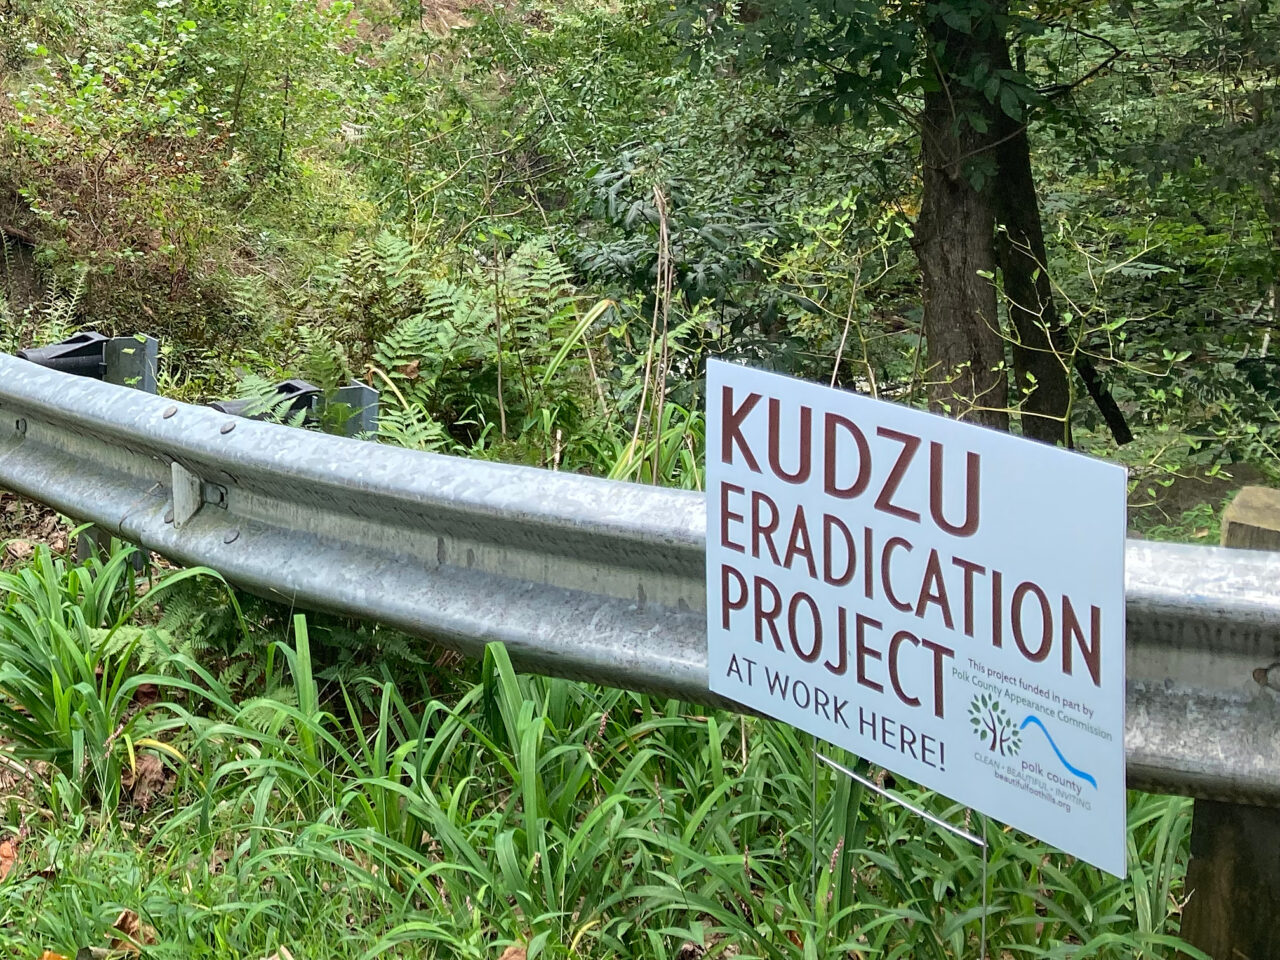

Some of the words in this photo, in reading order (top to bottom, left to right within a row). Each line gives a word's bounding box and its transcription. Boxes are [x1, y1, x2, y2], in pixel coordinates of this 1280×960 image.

[721, 385, 981, 538] KUDZU
[720, 481, 1101, 688] ERADICATION
[721, 564, 955, 719] PROJECT
[726, 653, 757, 689] AT
[764, 670, 850, 729] WORK
[859, 707, 946, 772] HERE!
[952, 667, 970, 683] Polk
[971, 675, 1002, 696] County
[1004, 689, 1056, 718] Appearance
[1057, 710, 1113, 742] Commission
[968, 658, 986, 674] This
[987, 666, 1017, 686] project
[1019, 678, 1050, 699] funded
[1052, 690, 1061, 704] in
[1063, 698, 1080, 715] part
[1082, 704, 1094, 719] by
[974, 751, 1001, 770] CLEAN
[1006, 765, 1049, 791] BEAUTIFUL
[1055, 784, 1092, 811] INVITING
[994, 770, 1071, 813] beautifulfoothills.org
[1021, 760, 1043, 777] polk
[1046, 772, 1082, 796] county
